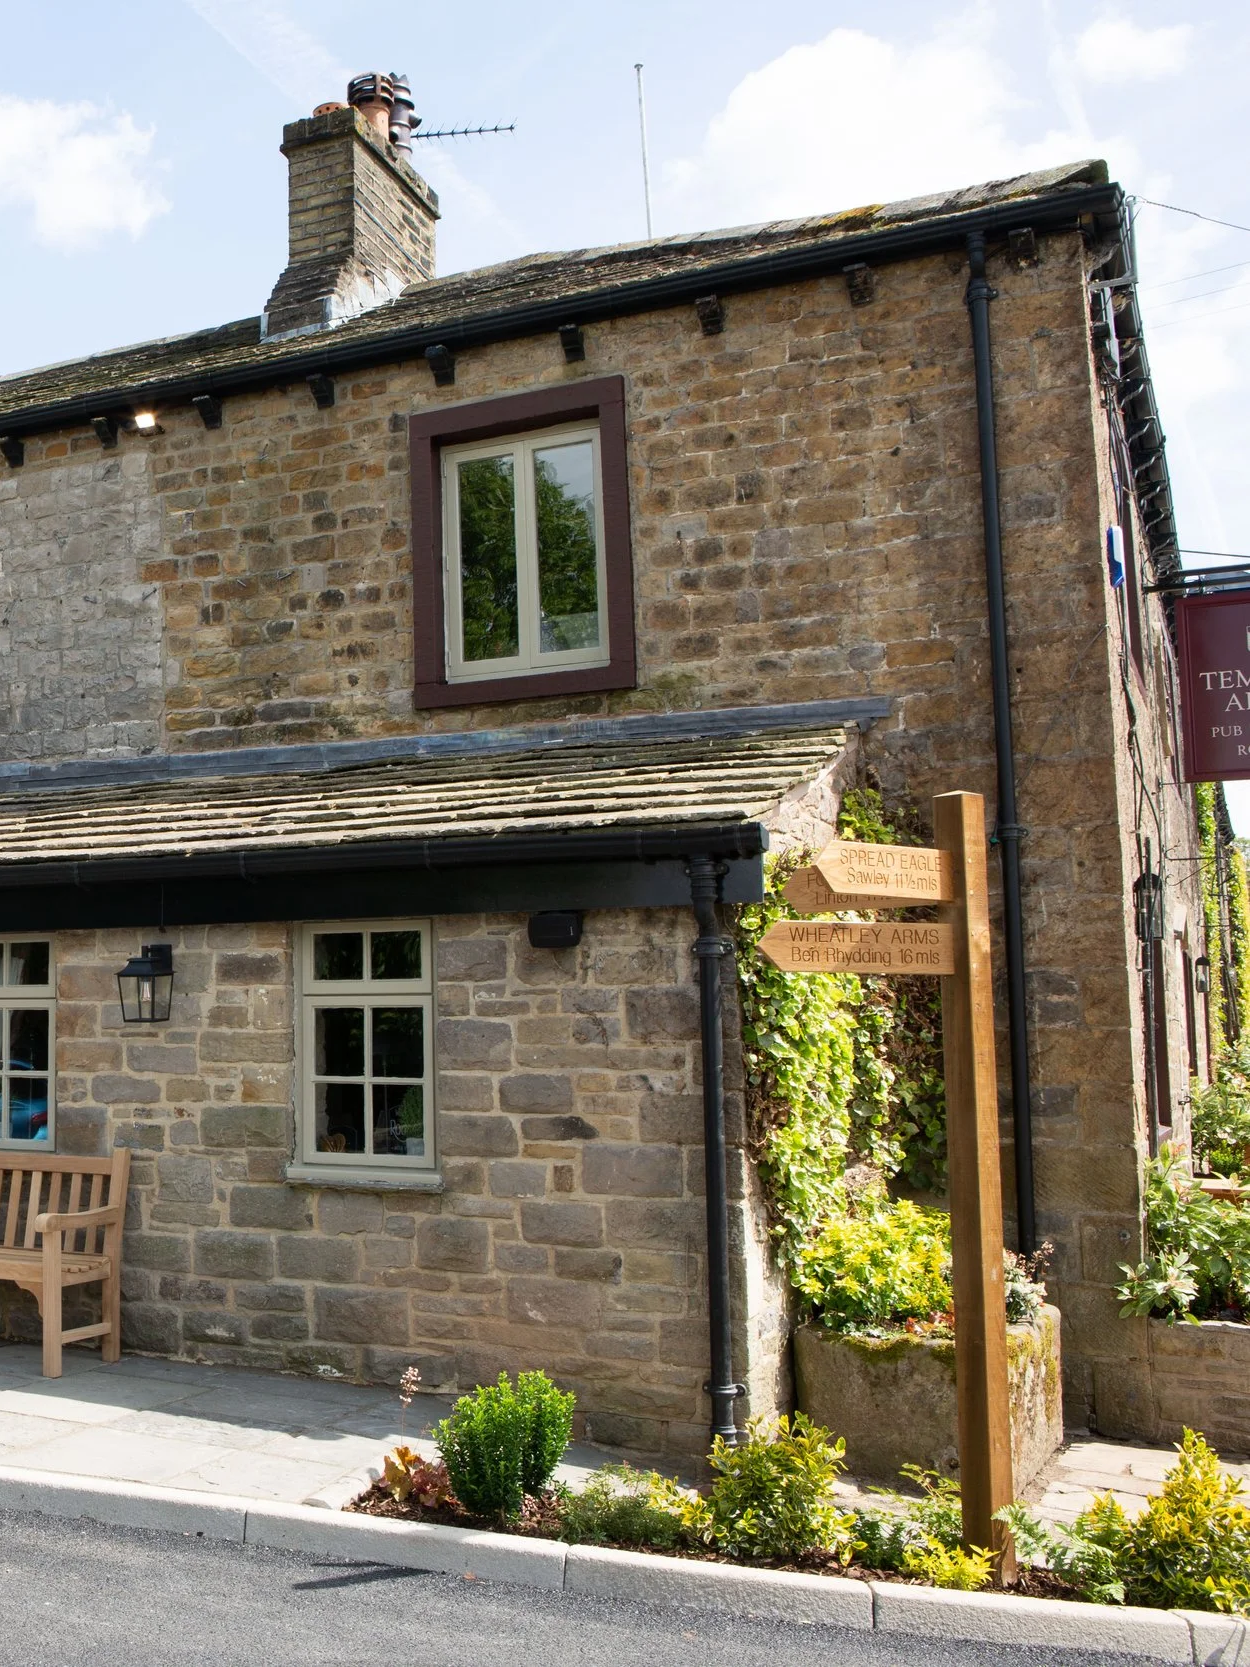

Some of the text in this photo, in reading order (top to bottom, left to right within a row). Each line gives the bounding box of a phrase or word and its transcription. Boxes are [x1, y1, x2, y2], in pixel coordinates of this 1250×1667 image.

[1211, 725, 1243, 738] PUB
[840, 848, 942, 872] SPREAD EAGLE
[847, 866, 890, 889] Sawley
[789, 926, 940, 945] WHEATLEY ARMS
[791, 946, 940, 967] Ben Rhydding 16 mls
